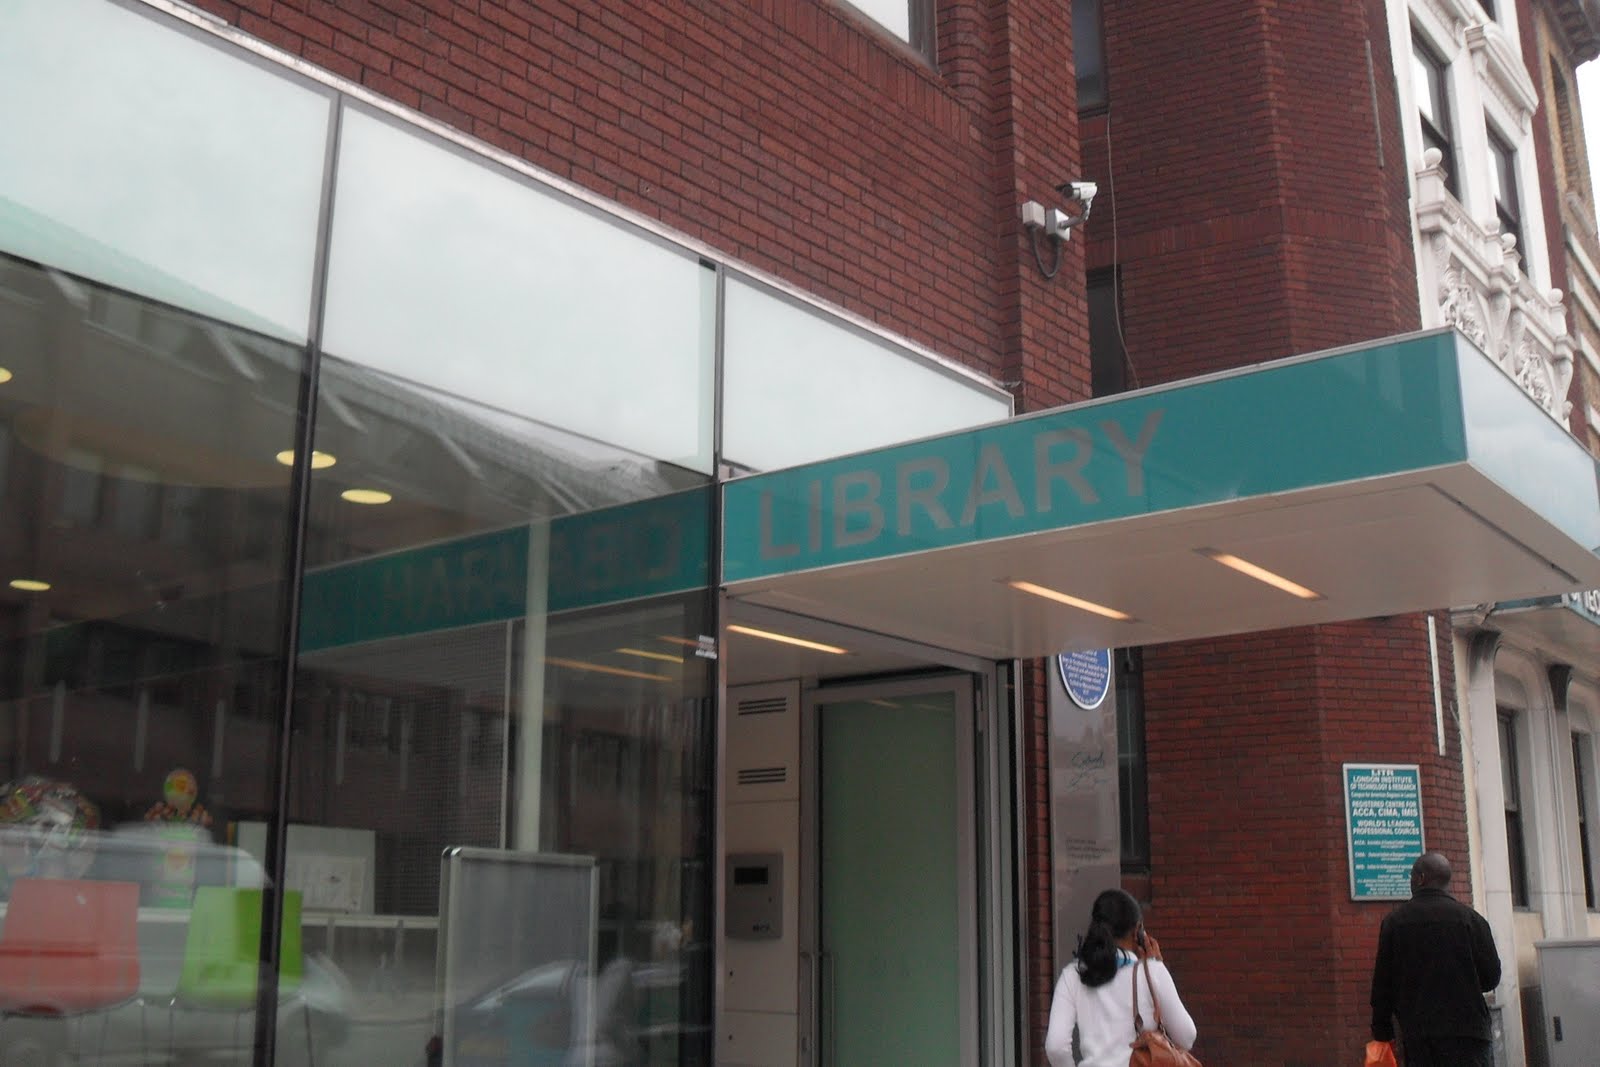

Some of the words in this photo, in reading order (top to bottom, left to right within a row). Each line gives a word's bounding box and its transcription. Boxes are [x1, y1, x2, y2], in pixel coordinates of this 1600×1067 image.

[758, 408, 1167, 561] LIBRARY
[1352, 775, 1380, 783] LONDON
[1380, 776, 1413, 784] INSTITUTE
[1357, 783, 1388, 791] TECHNOLOGY
[1352, 800, 1385, 808] REGISTERED
[1352, 808, 1377, 817] ACCA,
[1378, 808, 1401, 818] CIMA,
[1357, 820, 1387, 828] WORLD'S
[1387, 820, 1415, 828] LEADING
